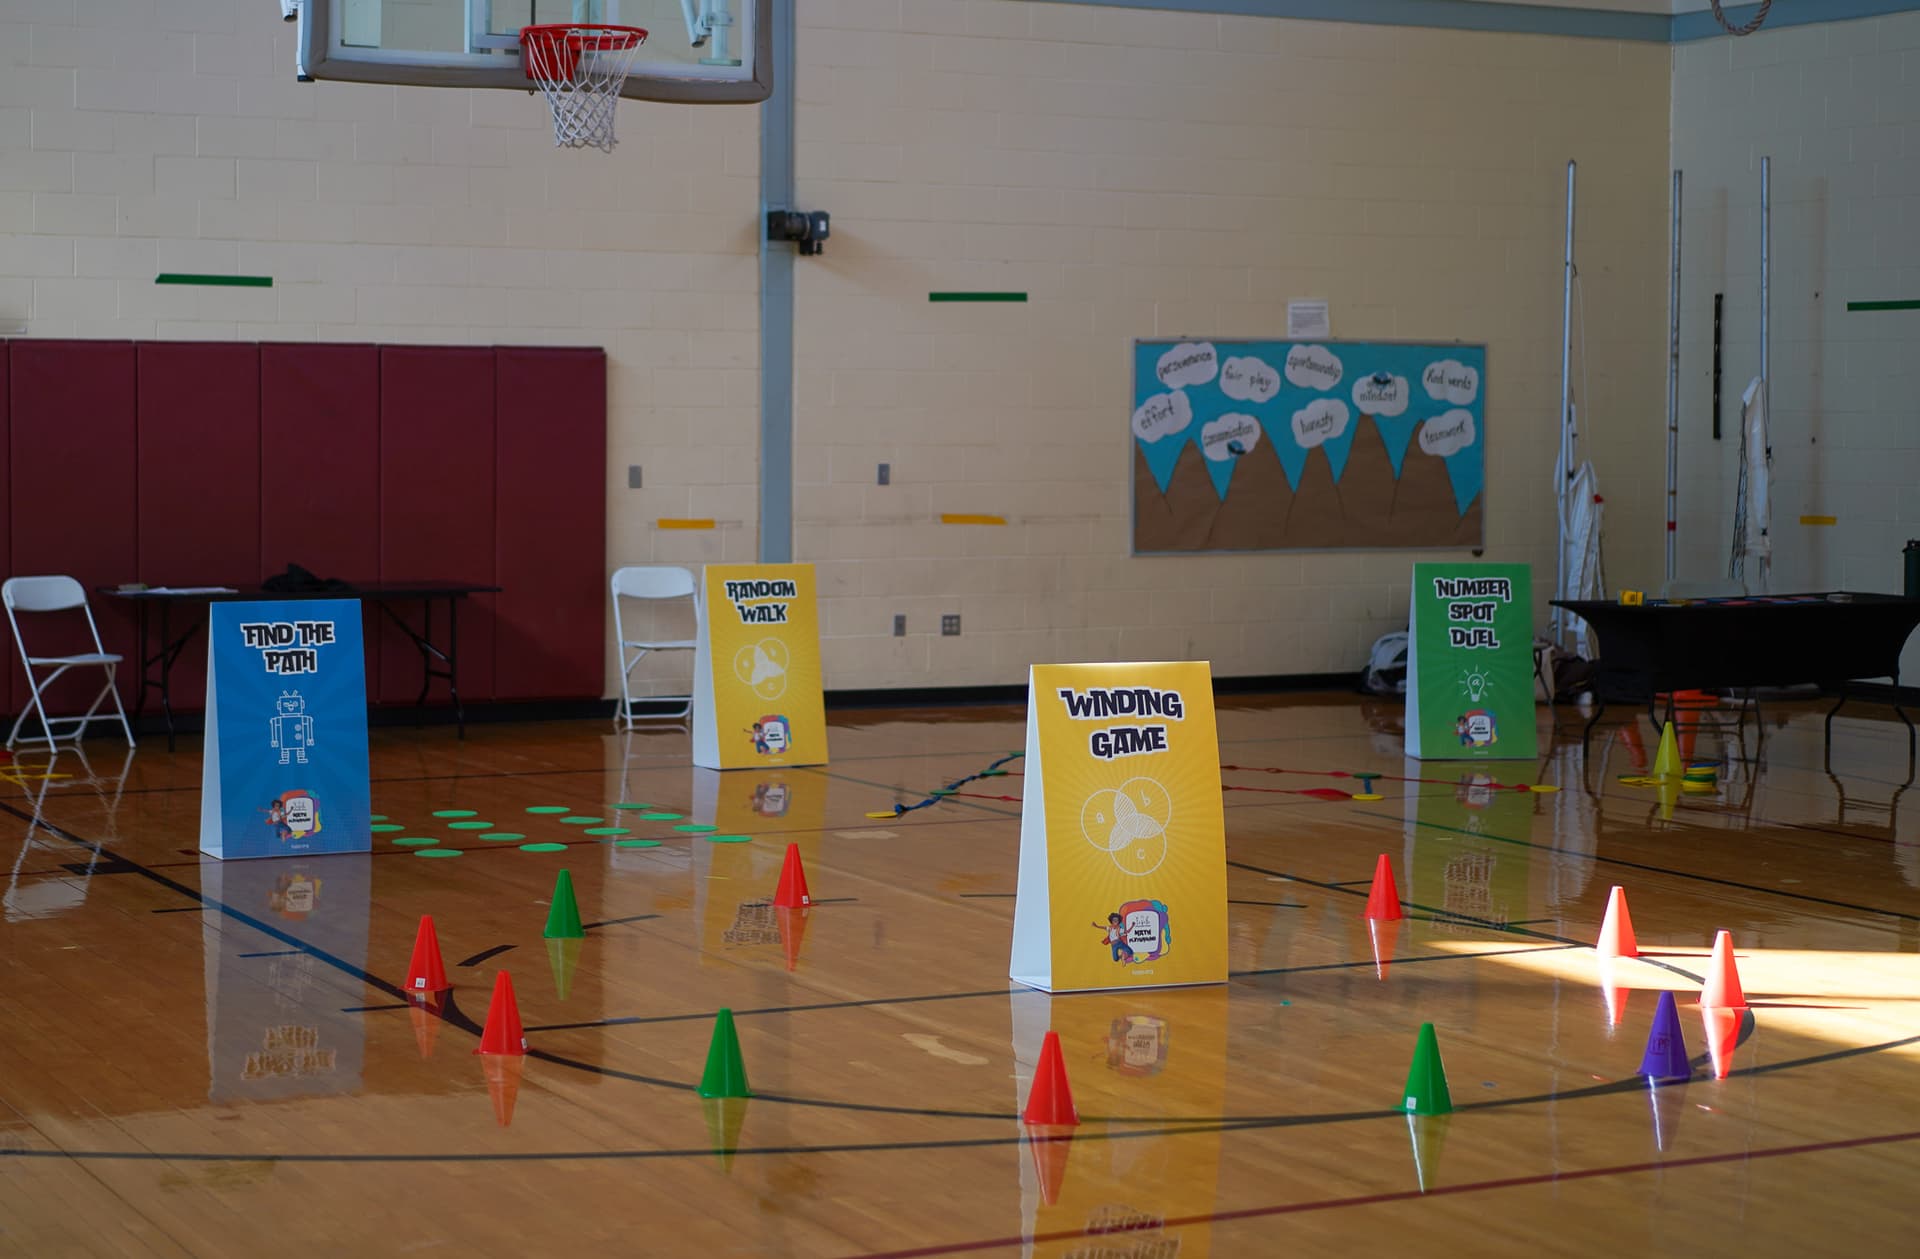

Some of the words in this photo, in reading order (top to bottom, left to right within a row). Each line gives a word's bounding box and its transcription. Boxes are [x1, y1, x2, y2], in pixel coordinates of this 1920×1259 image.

[1225, 364, 1243, 381] fair
[1250, 371, 1272, 392] play
[1140, 398, 1176, 430] effort
[1300, 412, 1334, 435] honesty
[1426, 420, 1465, 444] teamwork
[725, 580, 797, 602] RANDOM
[1434, 578, 1511, 602] NUMBER
[736, 604, 788, 623] WALK
[1449, 602, 1496, 622] SPOT
[241, 623, 294, 648] FIND
[295, 622, 335, 646] THE
[1450, 628, 1500, 648] DUEL
[263, 649, 317, 674] PATH
[1058, 687, 1184, 719] WINDING
[1090, 726, 1168, 760] GAME
